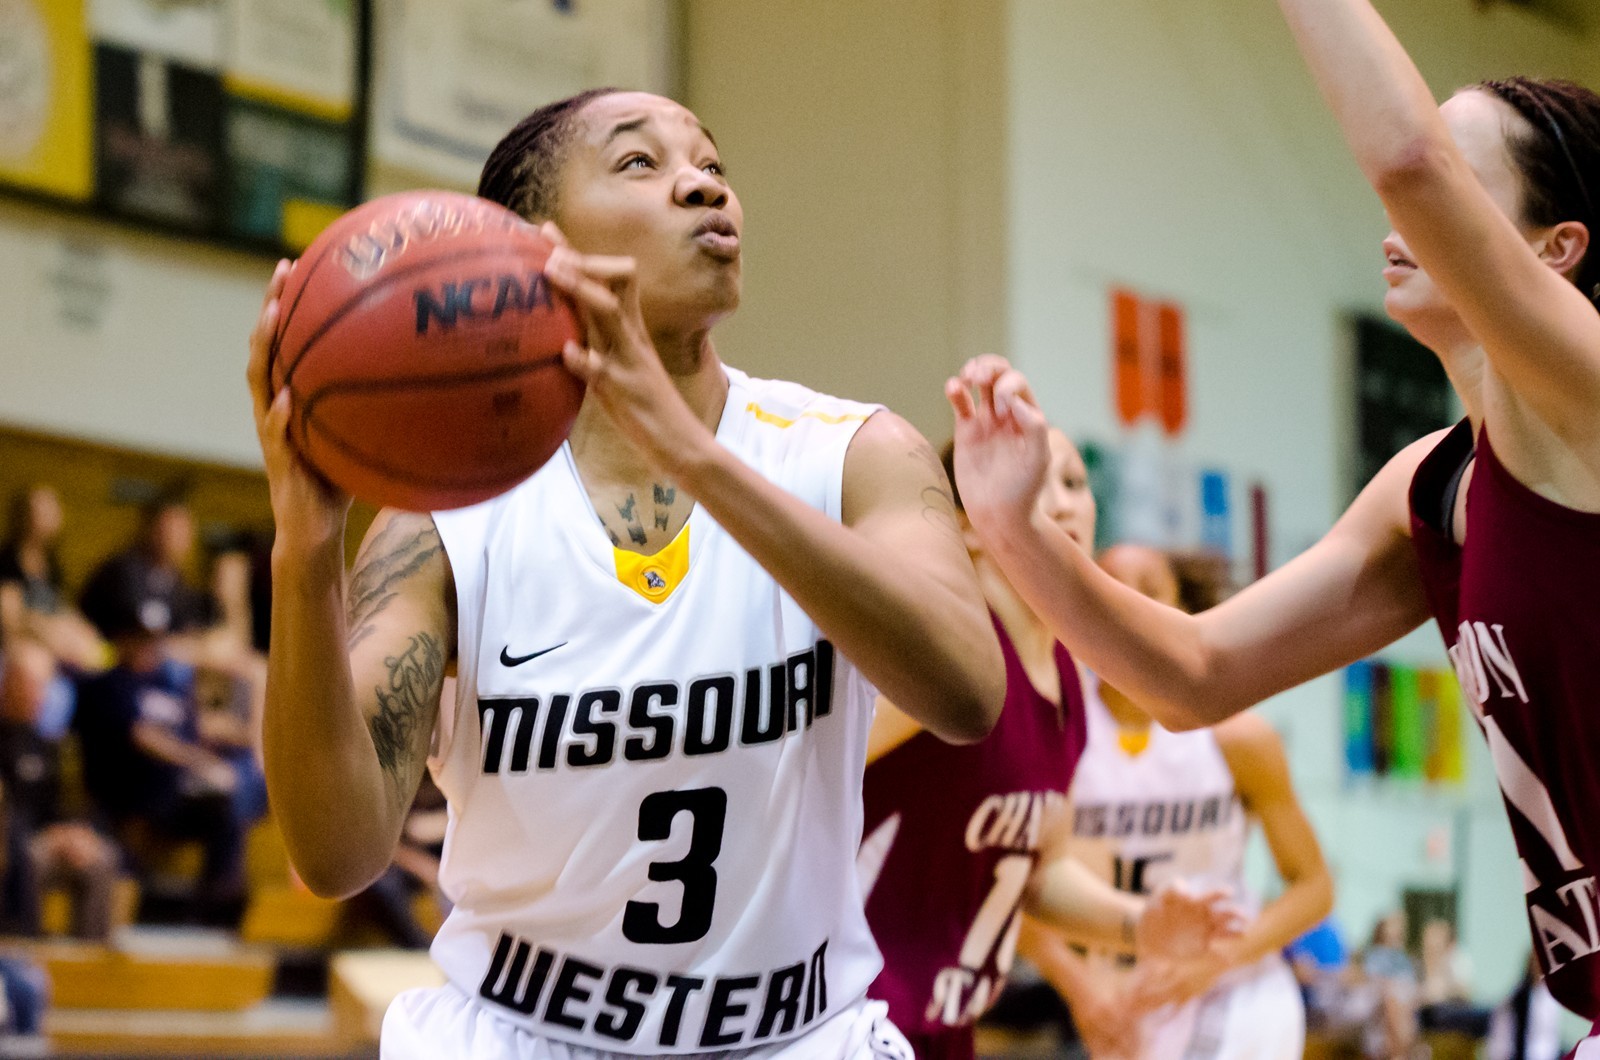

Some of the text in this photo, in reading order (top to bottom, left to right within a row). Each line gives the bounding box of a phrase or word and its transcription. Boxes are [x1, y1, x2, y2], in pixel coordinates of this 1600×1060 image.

[413, 268, 554, 334] NCAA
[478, 638, 835, 775] MISSOURI
[621, 786, 728, 945] 3
[964, 790, 1064, 852] CHA
[1073, 798, 1233, 837] ISSOURI
[958, 854, 1033, 976] 1
[1530, 876, 1600, 974] AT
[479, 930, 830, 1048] WESTERN
